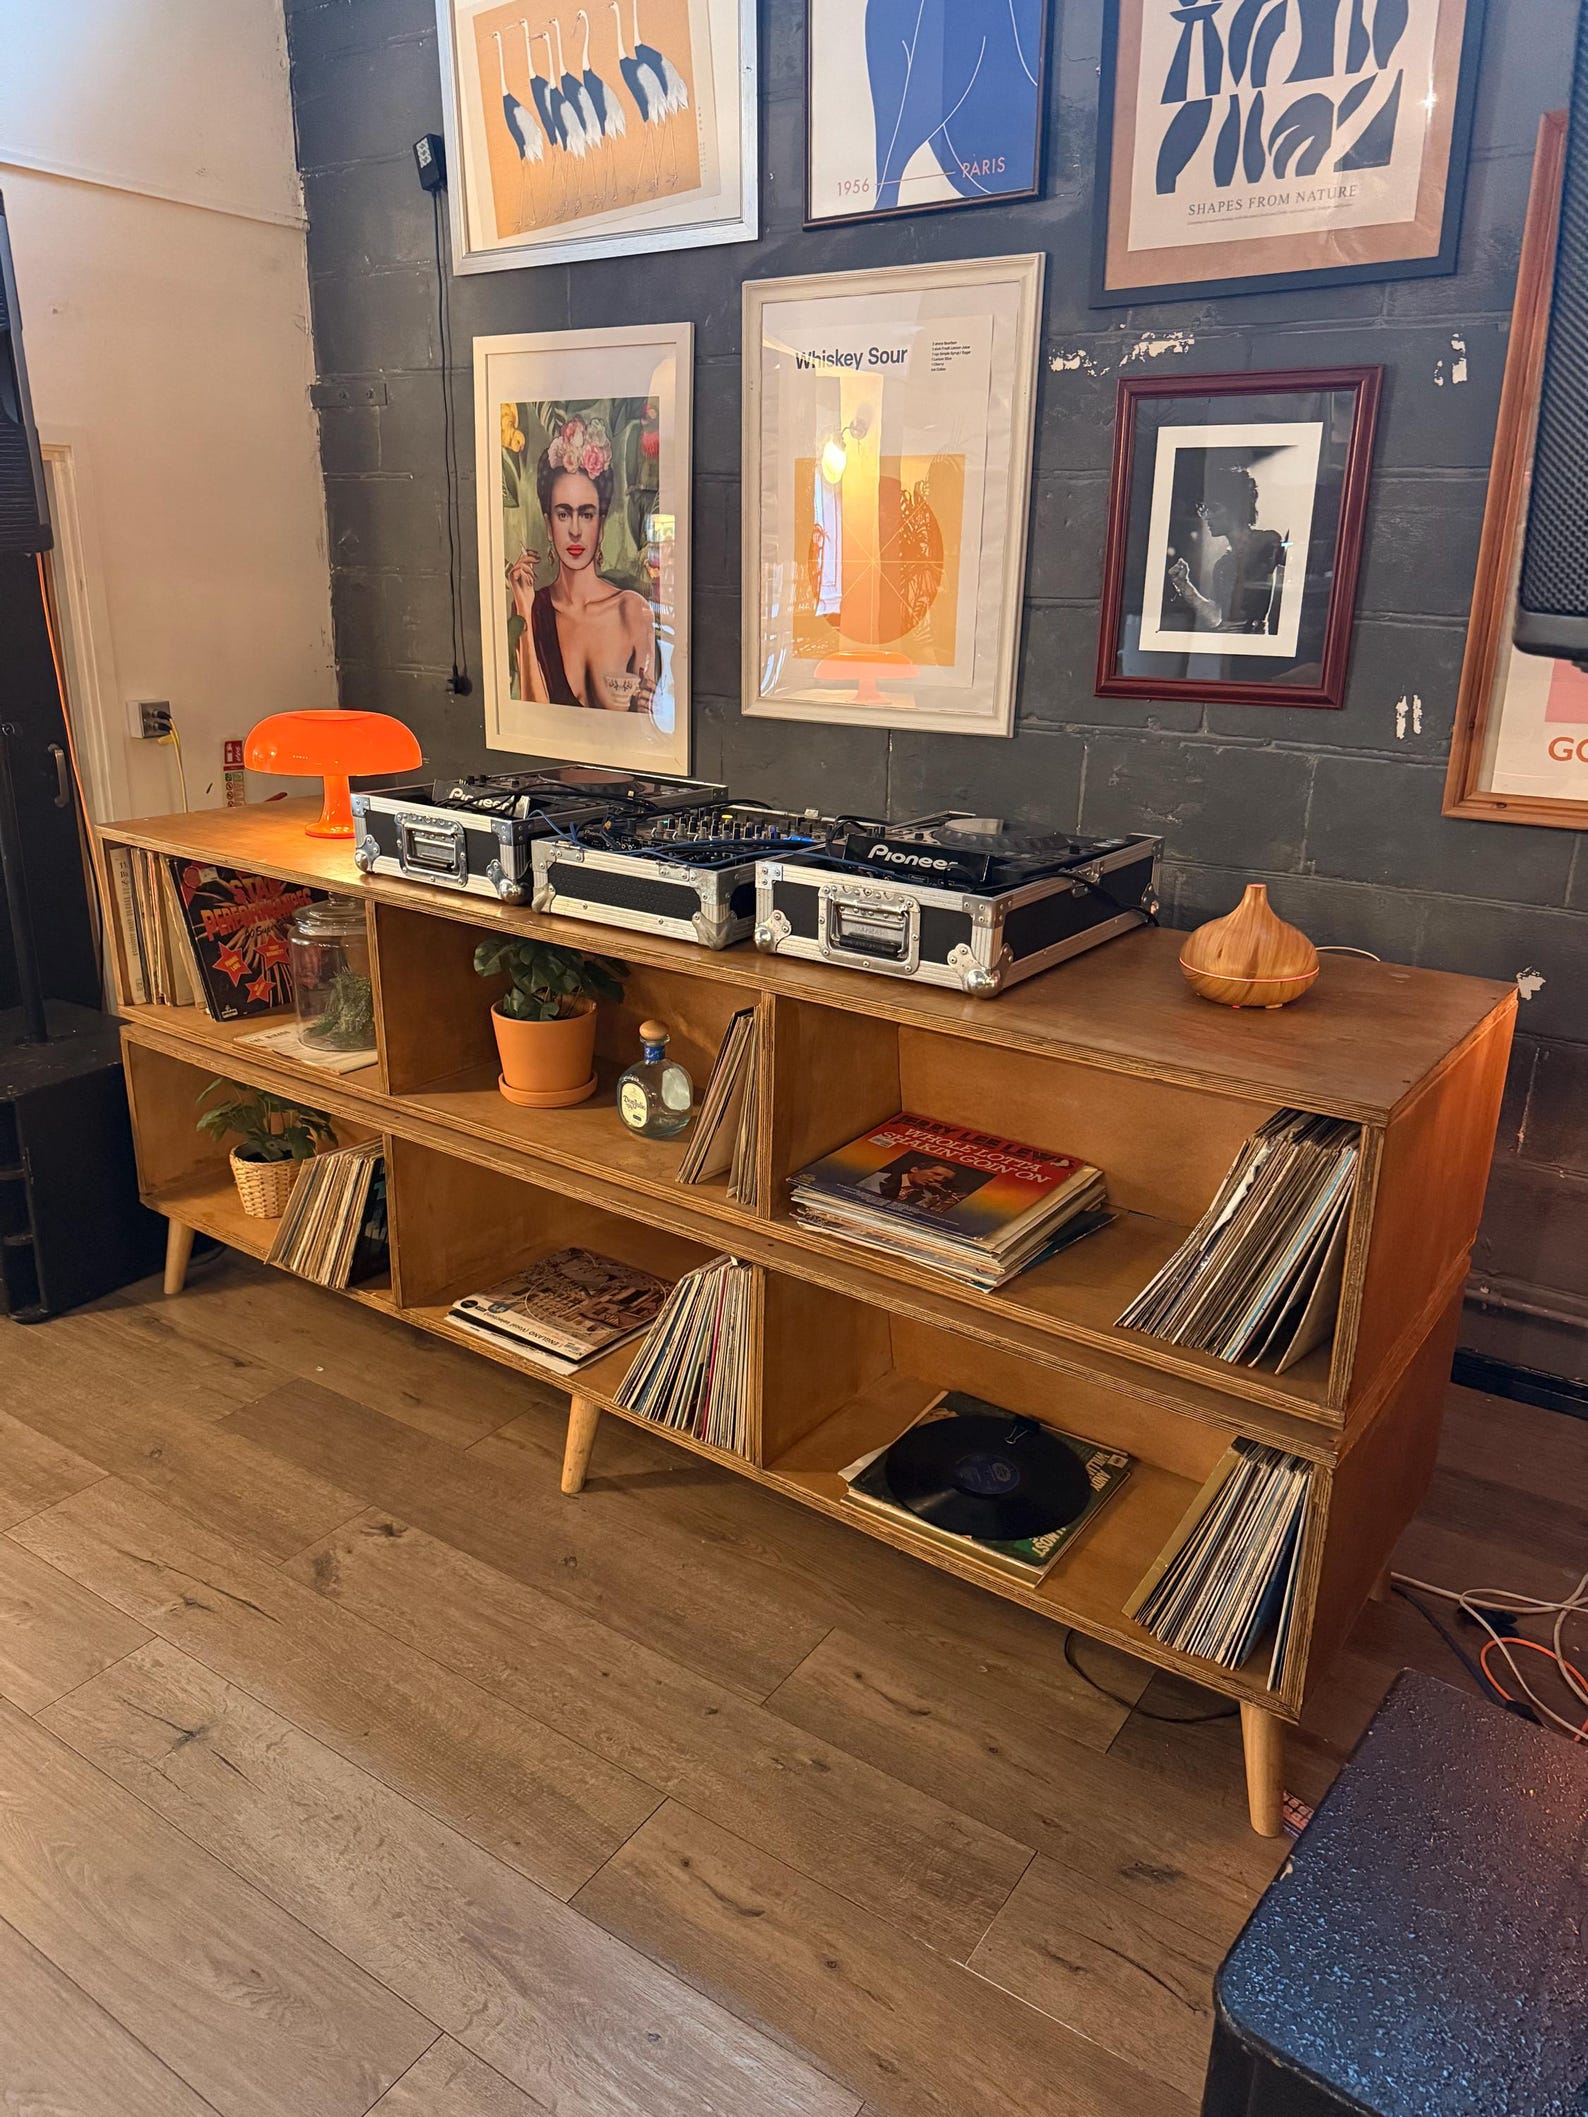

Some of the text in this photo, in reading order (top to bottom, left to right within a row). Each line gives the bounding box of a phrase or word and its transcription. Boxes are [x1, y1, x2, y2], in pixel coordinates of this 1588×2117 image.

[837, 157, 1006, 196] 1956 PARIS
[1188, 200, 1243, 216] SHAPES
[1248, 193, 1290, 209] FROM
[1296, 184, 1358, 203] NATURE
[795, 347, 908, 370] Whiskey Sour
[868, 844, 959, 871] Pioneer
[890, 1114, 956, 1135] JERRY
[959, 1131, 1002, 1149] LEE
[883, 1131, 960, 1159] SHAKIN'
[1015, 1171, 1051, 1184] ON
[904, 1128, 1042, 1173] WHOLE LOTTA
[529, 1331, 559, 1346] ENGLAND
[1085, 1451, 1110, 1478] WILLI
[1090, 1469, 1111, 1492] ANDY
[1032, 1527, 1067, 1557] MOST
